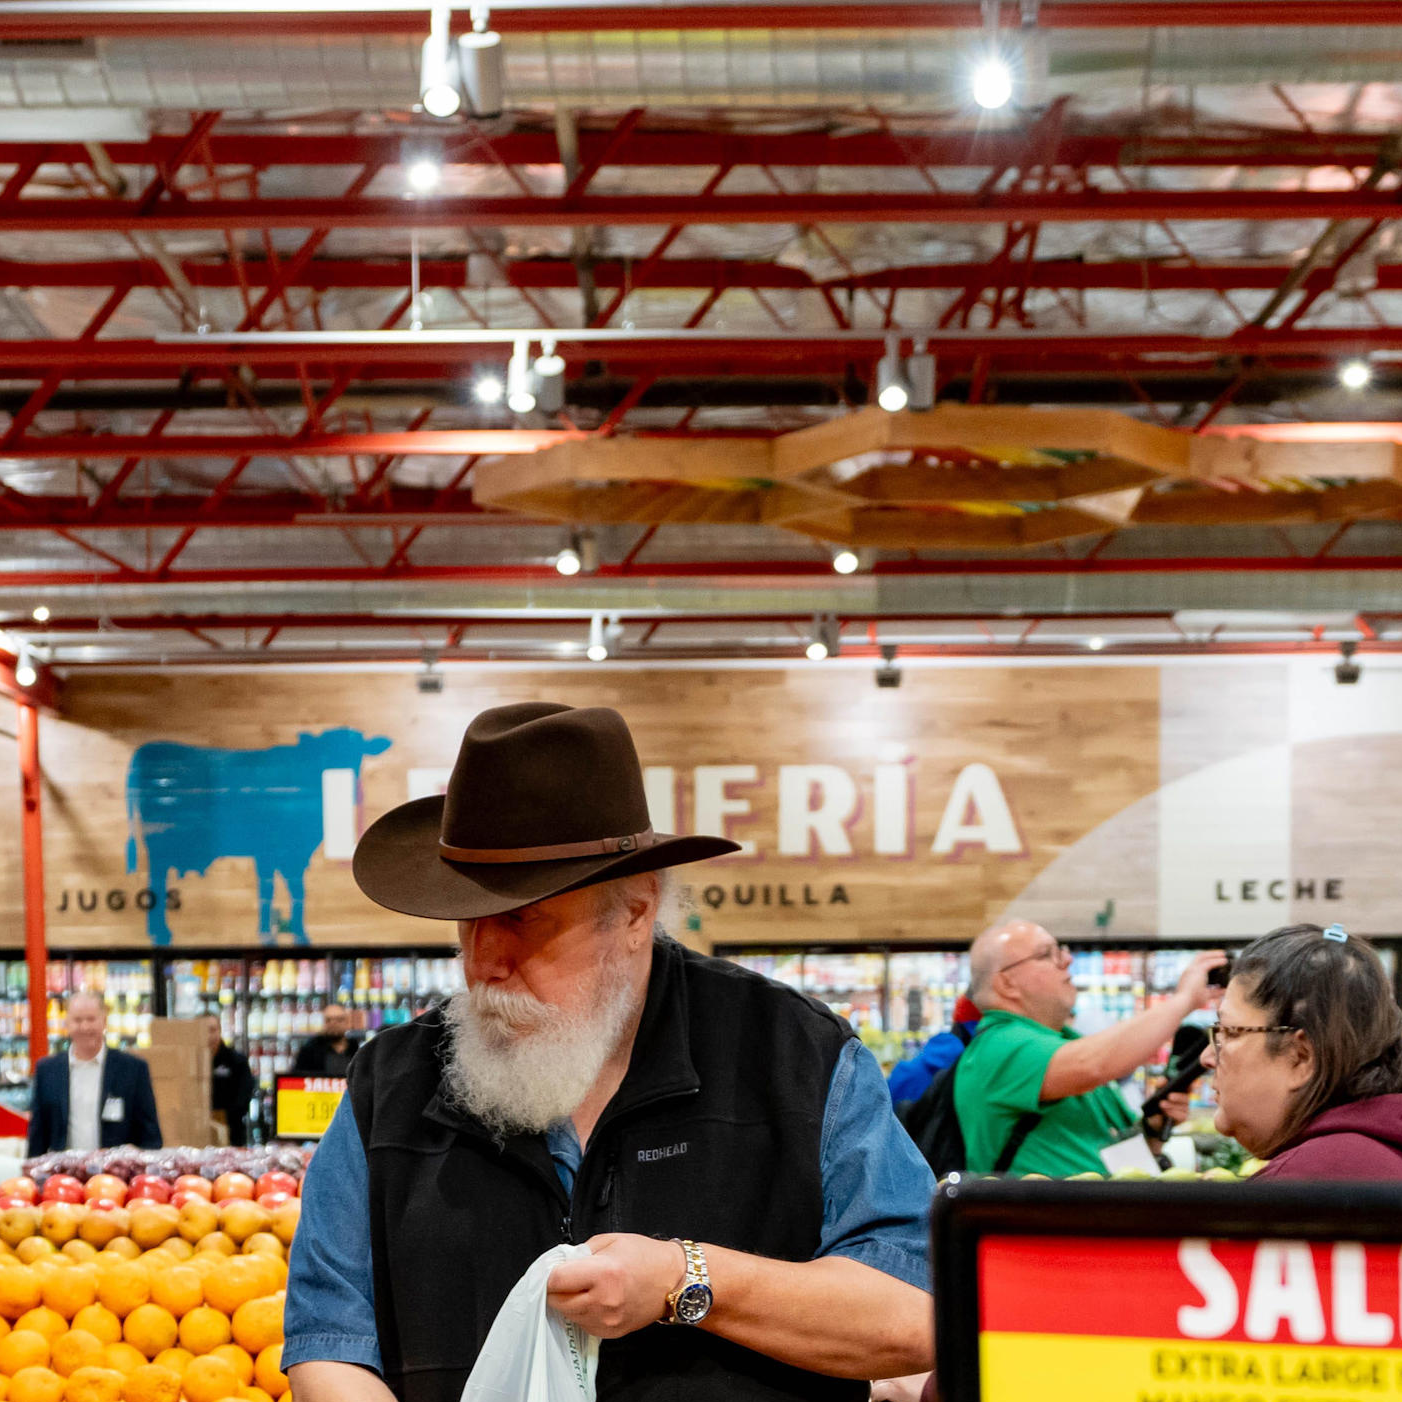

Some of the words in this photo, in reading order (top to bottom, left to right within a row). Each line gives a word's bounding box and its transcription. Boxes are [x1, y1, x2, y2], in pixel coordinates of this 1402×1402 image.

[322, 754, 1022, 858] LERÍA
[57, 888, 181, 912] JUGOS
[702, 883, 850, 909] QUILLA
[1215, 878, 1343, 901] LECHE
[638, 1142, 688, 1161] REDHEAD
[1152, 1350, 1262, 1382] EXTRA
[1271, 1355, 1383, 1389] LARGE
